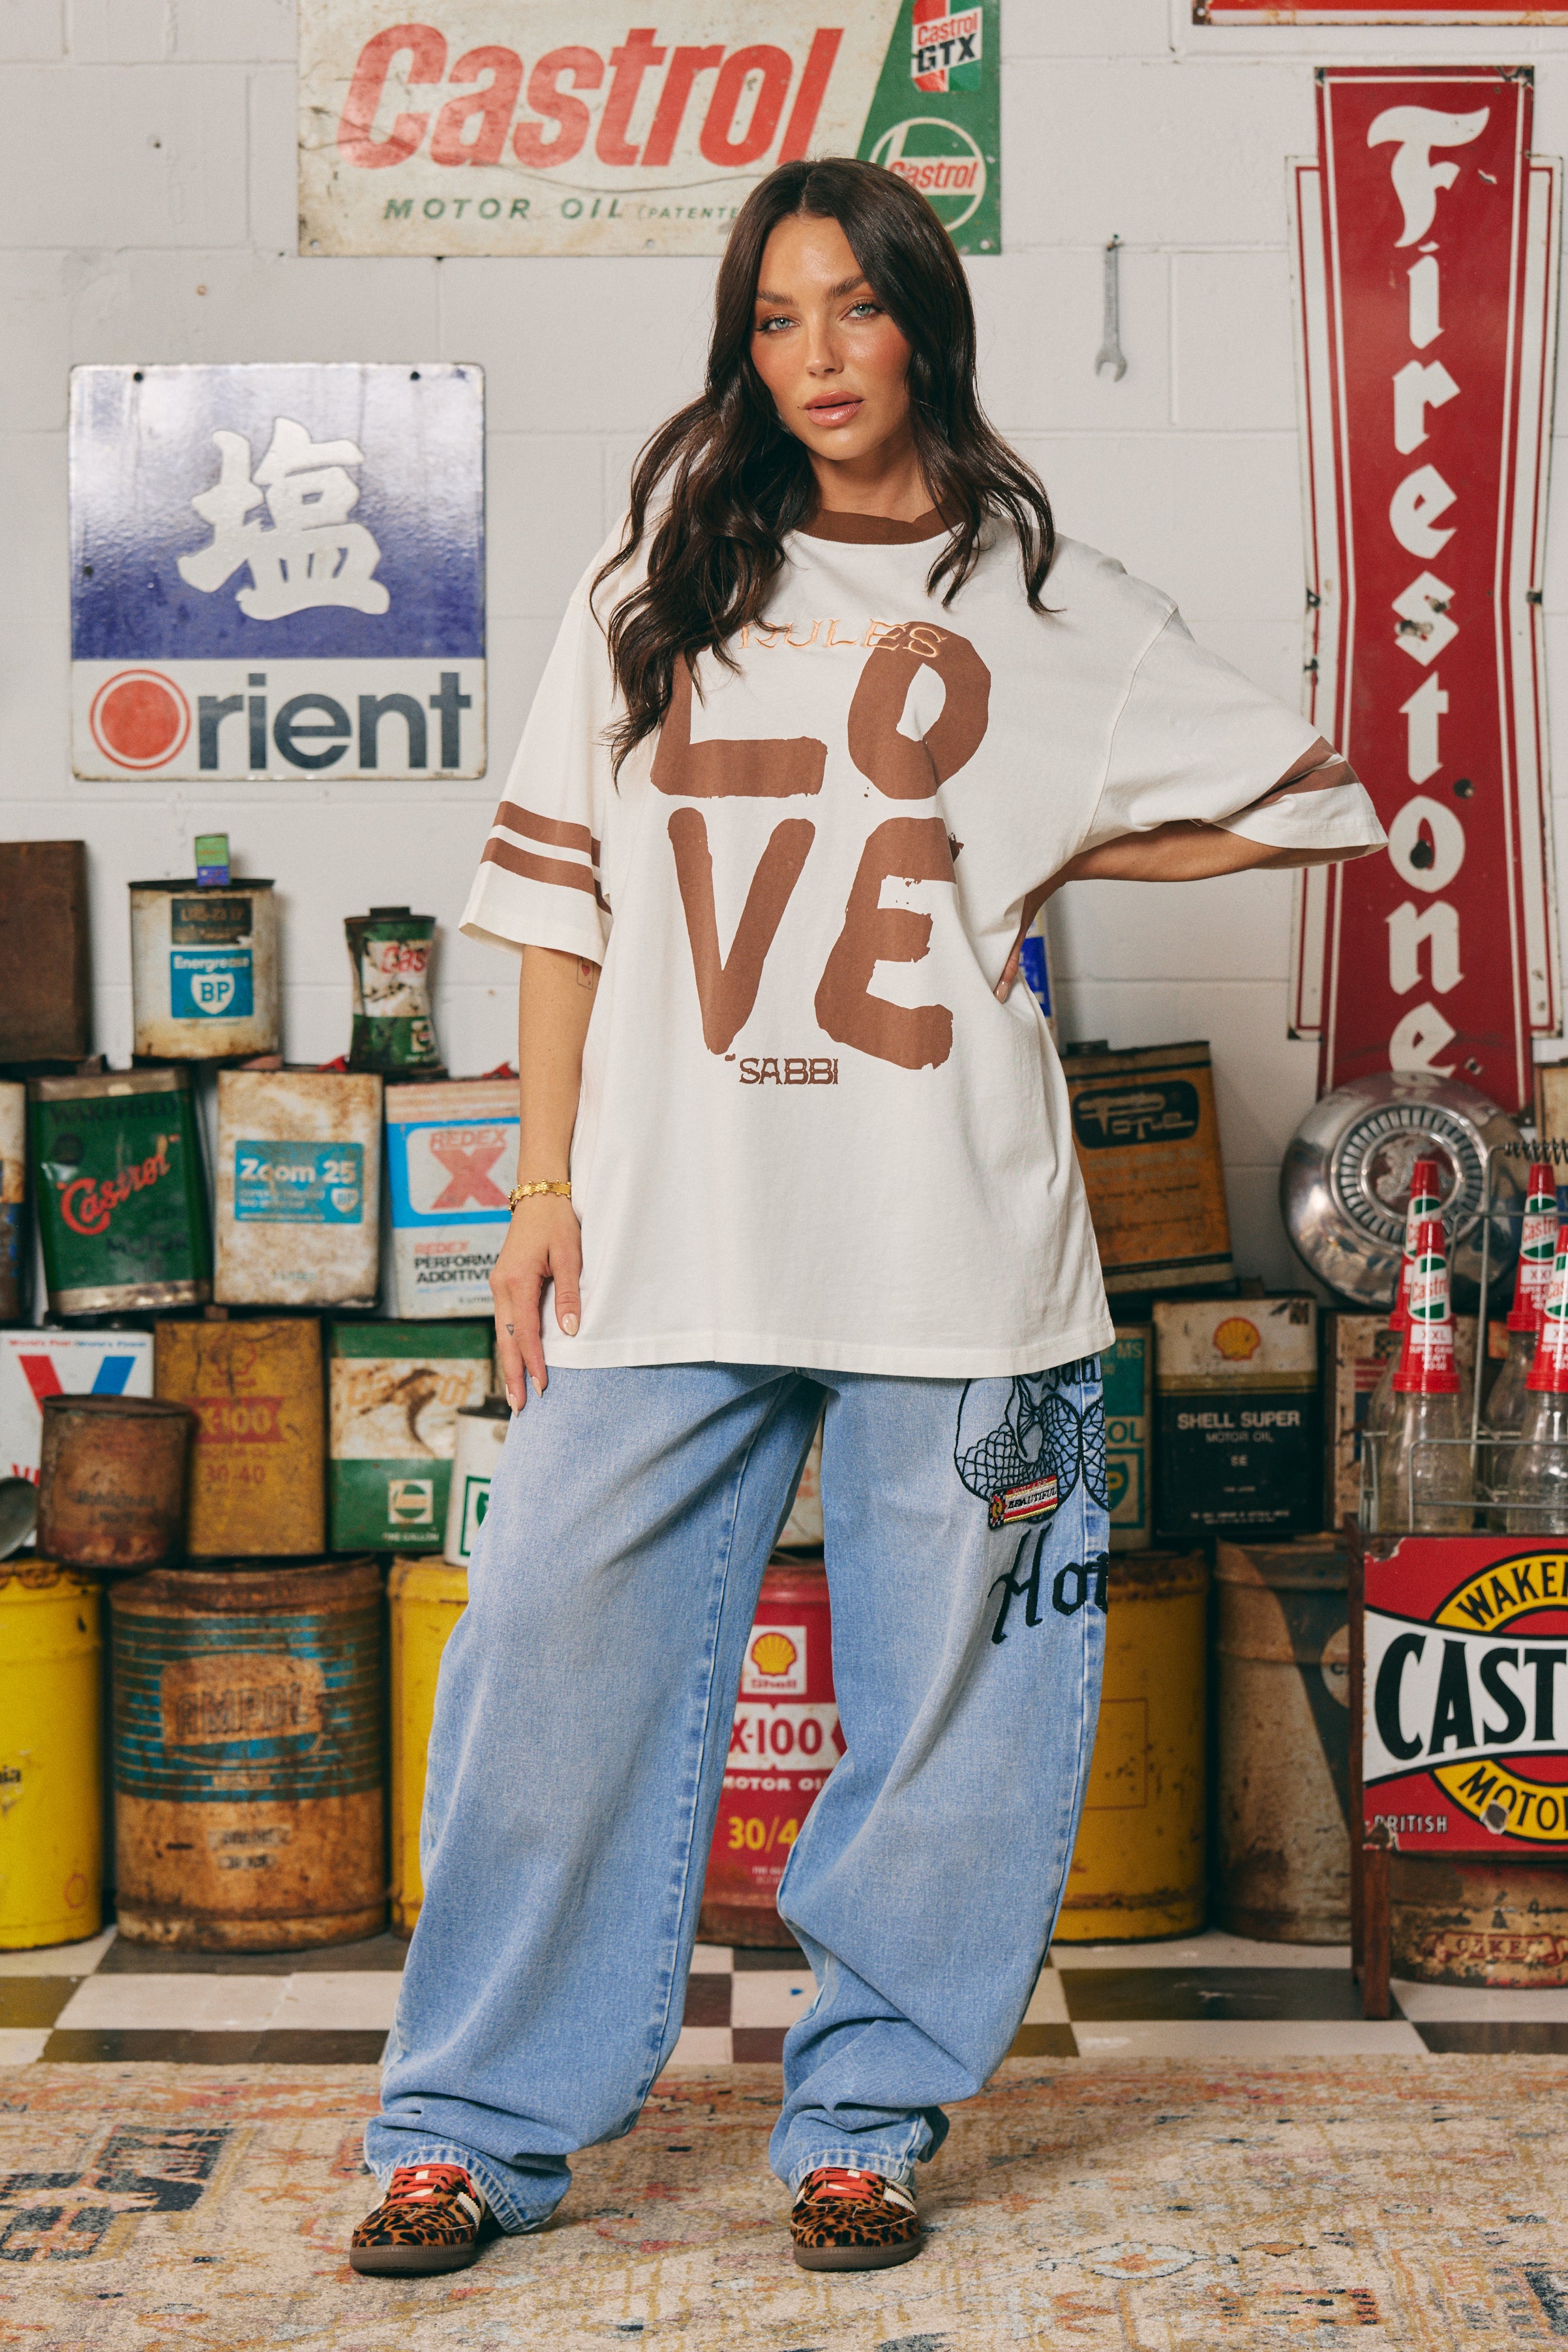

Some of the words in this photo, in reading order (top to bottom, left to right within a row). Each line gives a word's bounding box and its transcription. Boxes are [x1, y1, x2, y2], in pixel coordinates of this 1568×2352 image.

[917, 12, 978, 46] Castrol
[917, 34, 976, 73] GTX
[337, 23, 844, 169] Castrol
[383, 198, 530, 220] MOTOR
[560, 198, 623, 220] OIL
[176, 416, 391, 621] 塩
[1367, 106, 1490, 1078] Firestone
[738, 618, 948, 658] RULES
[200, 981, 231, 1003] BP
[740, 1058, 838, 1084] SABBI
[430, 1128, 507, 1152] REDEX
[240, 1158, 316, 1183] Zoom
[322, 1160, 357, 1184] 25
[413, 1240, 469, 1254] REDEX
[1177, 1412, 1235, 1429] SHELL
[1240, 1410, 1301, 1428] SUPER
[1206, 1431, 1248, 1443] MOTOR
[1252, 1431, 1274, 1443] OIL
[1032, 1478, 1048, 1488] ARE
[1008, 1488, 1057, 1509] BEAUTIFUL
[1456, 1561, 1568, 1627] WAKE
[752, 1679, 797, 1689] Shell
[1374, 1632, 1567, 1760] CAST
[729, 1718, 823, 1755] X-100
[798, 1777, 824, 1792] OI
[1458, 1765, 1568, 1831] MOTO
